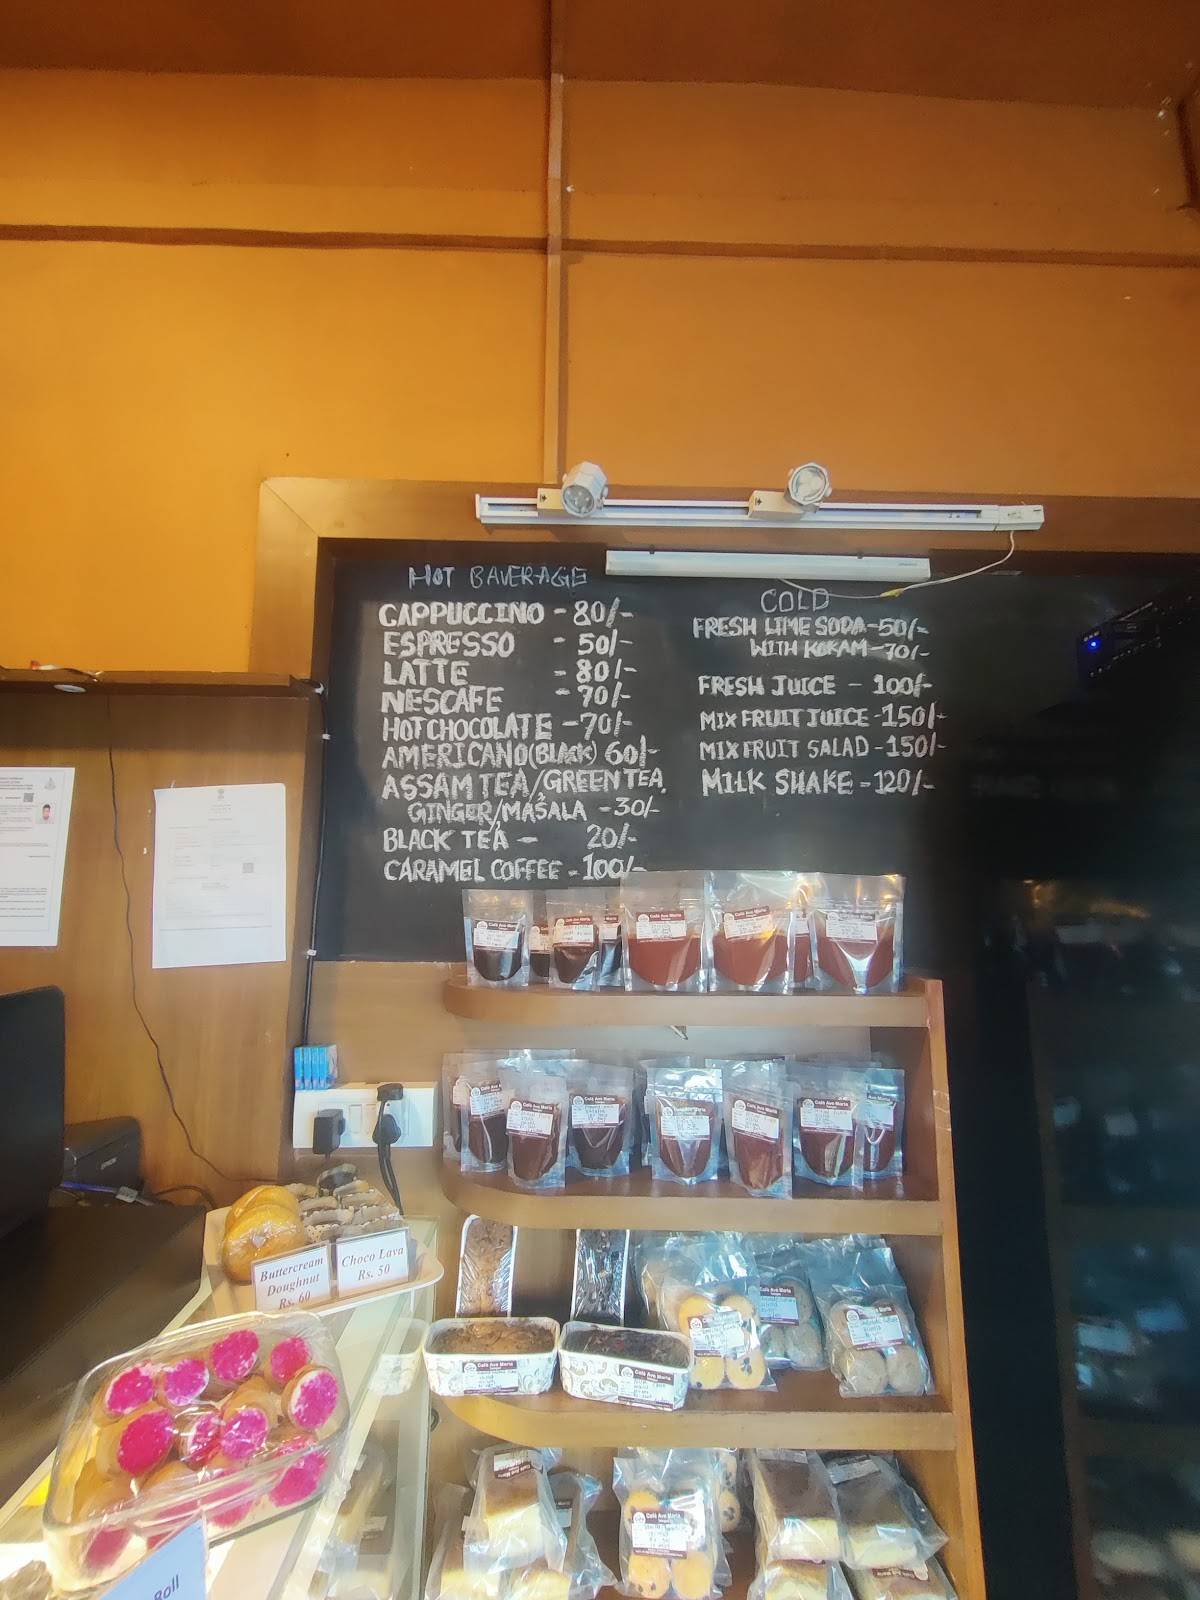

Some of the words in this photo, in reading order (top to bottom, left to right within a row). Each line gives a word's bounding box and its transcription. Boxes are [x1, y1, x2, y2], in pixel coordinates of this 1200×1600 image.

[408, 564, 455, 590] HOT
[469, 564, 588, 589] BAVERAGE
[760, 588, 830, 613] COLD
[378, 601, 546, 628] CAPPUCCINO
[692, 615, 757, 639] FRESH
[764, 616, 812, 637] LIME
[383, 629, 516, 658] ESPRESSO
[749, 638, 798, 658] WITH
[383, 658, 471, 687] LATTE
[697, 674, 766, 697] FRESH
[770, 674, 837, 697] JUICE
[380, 685, 505, 715] NESCAFE
[699, 710, 738, 732] MIX
[741, 707, 803, 729] FRUIT
[806, 707, 870, 728] JUICE
[699, 739, 740, 761] MIX
[742, 737, 801, 761] FRUIT
[806, 734, 870, 760] SALAD
[381, 771, 473, 801] ASSAM
[701, 766, 768, 797] MILK
[774, 767, 854, 796] SHAKE
[383, 827, 456, 853] BLACK
[461, 824, 510, 851] TEA
[585, 822, 638, 850] 20/-
[383, 856, 486, 884] CARAMEL
[490, 857, 563, 882] COFFEE
[259, 1257, 325, 1283] Buttercream
[341, 1250, 376, 1269] Choco
[378, 1246, 405, 1262] Lava
[266, 1273, 321, 1298] Doughnut
[357, 1267, 375, 1282] Rs.
[378, 1263, 391, 1278] 50
[279, 1296, 296, 1310] Rs.
[299, 1290, 312, 1306] 60
